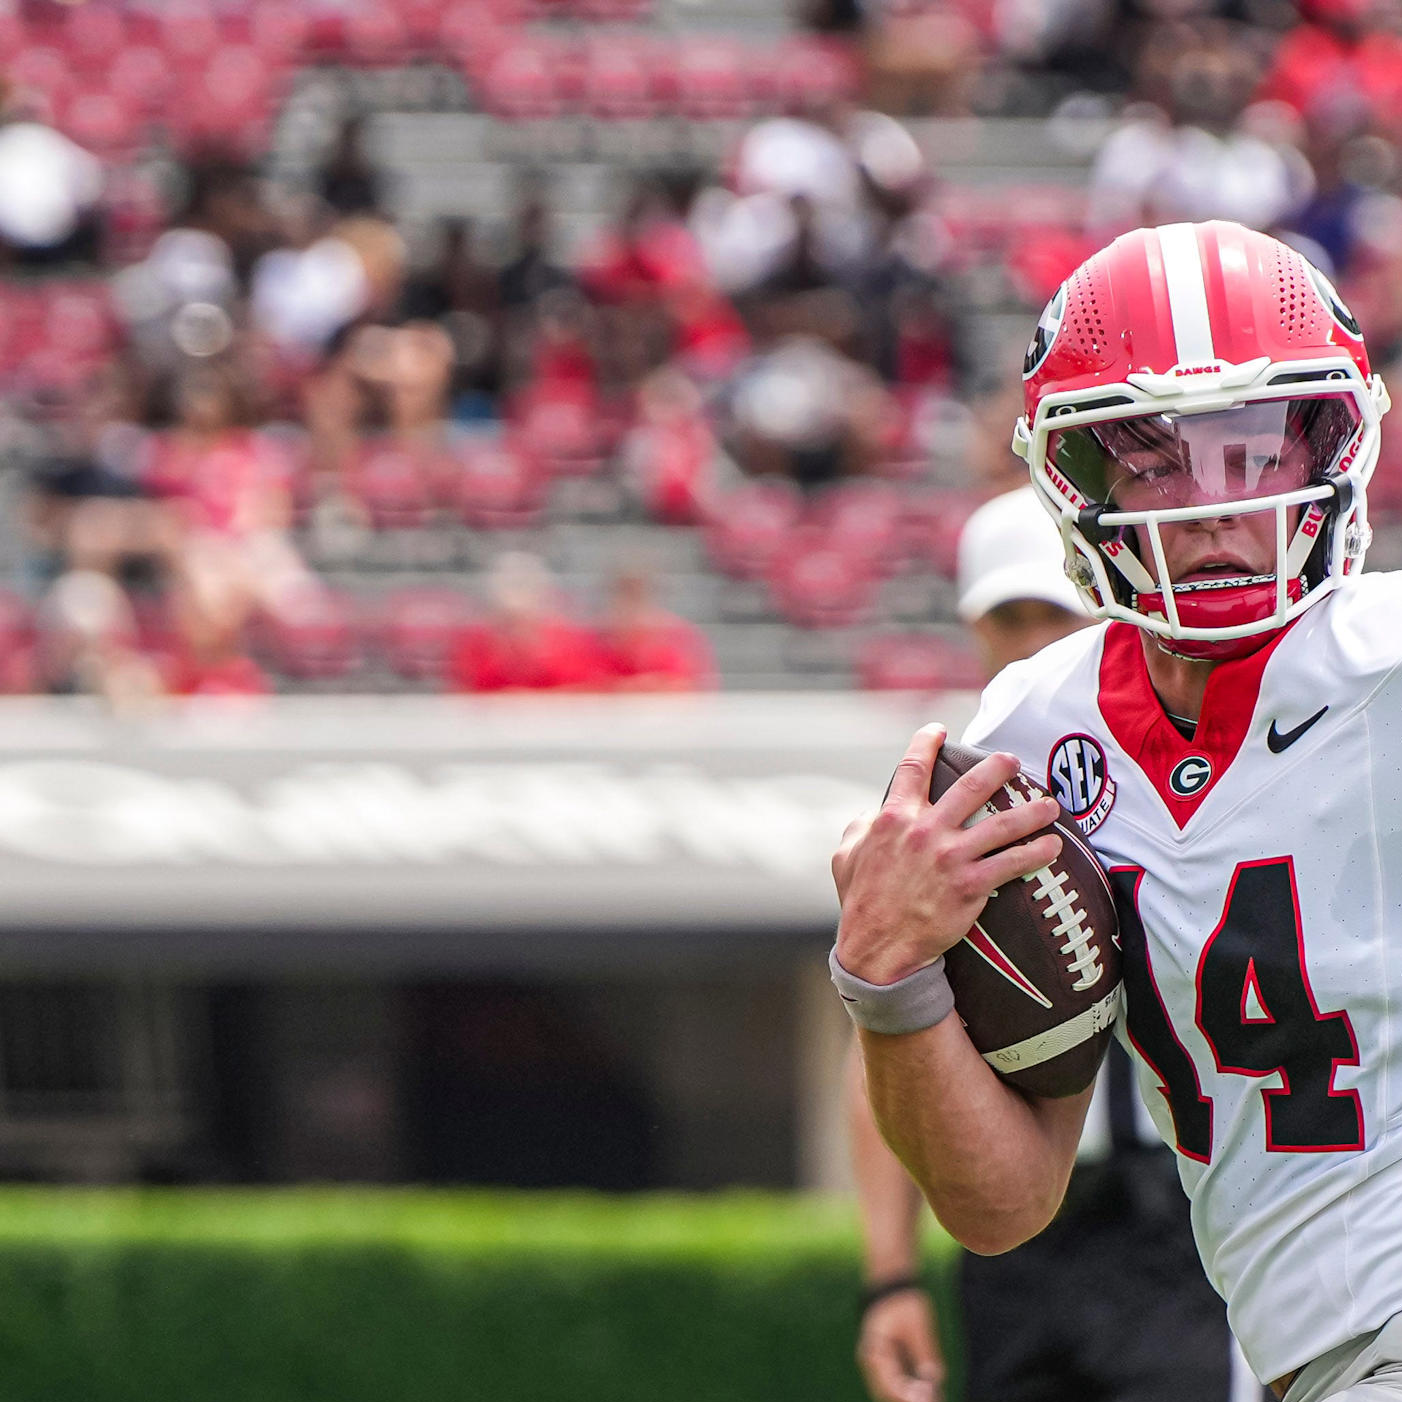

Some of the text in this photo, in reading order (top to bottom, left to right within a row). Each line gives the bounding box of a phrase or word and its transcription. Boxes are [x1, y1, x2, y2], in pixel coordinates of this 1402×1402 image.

[1175, 366, 1221, 377] DAWGS
[1050, 738, 1102, 814] SEC
[1109, 855, 1365, 1166] 14
